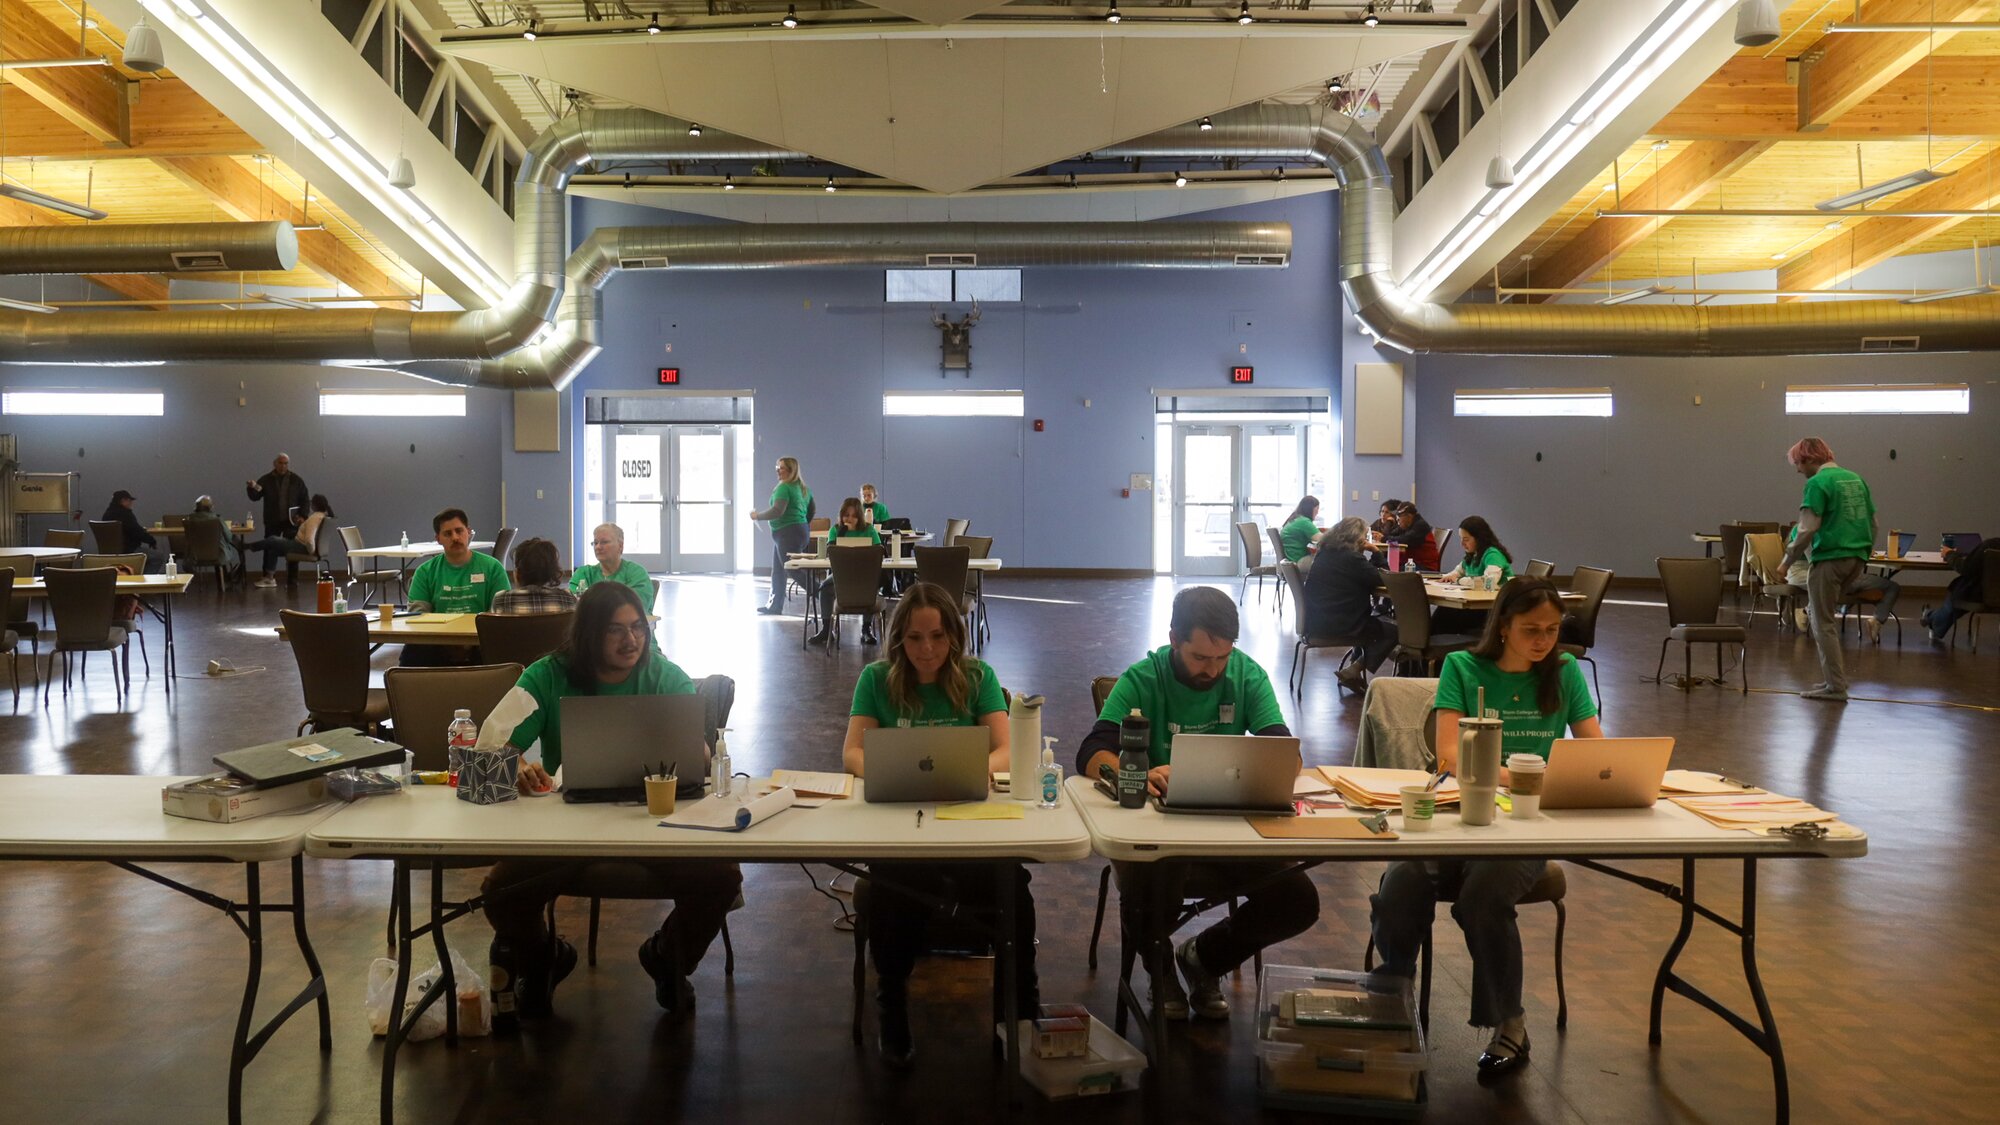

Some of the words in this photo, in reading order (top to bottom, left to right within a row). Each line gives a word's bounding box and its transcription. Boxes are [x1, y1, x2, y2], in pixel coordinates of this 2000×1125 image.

[661, 369, 677, 382] EXIT
[1235, 369, 1251, 381] EXIT
[622, 460, 651, 478] CLOSED
[1526, 730, 1555, 738] PROJECT
